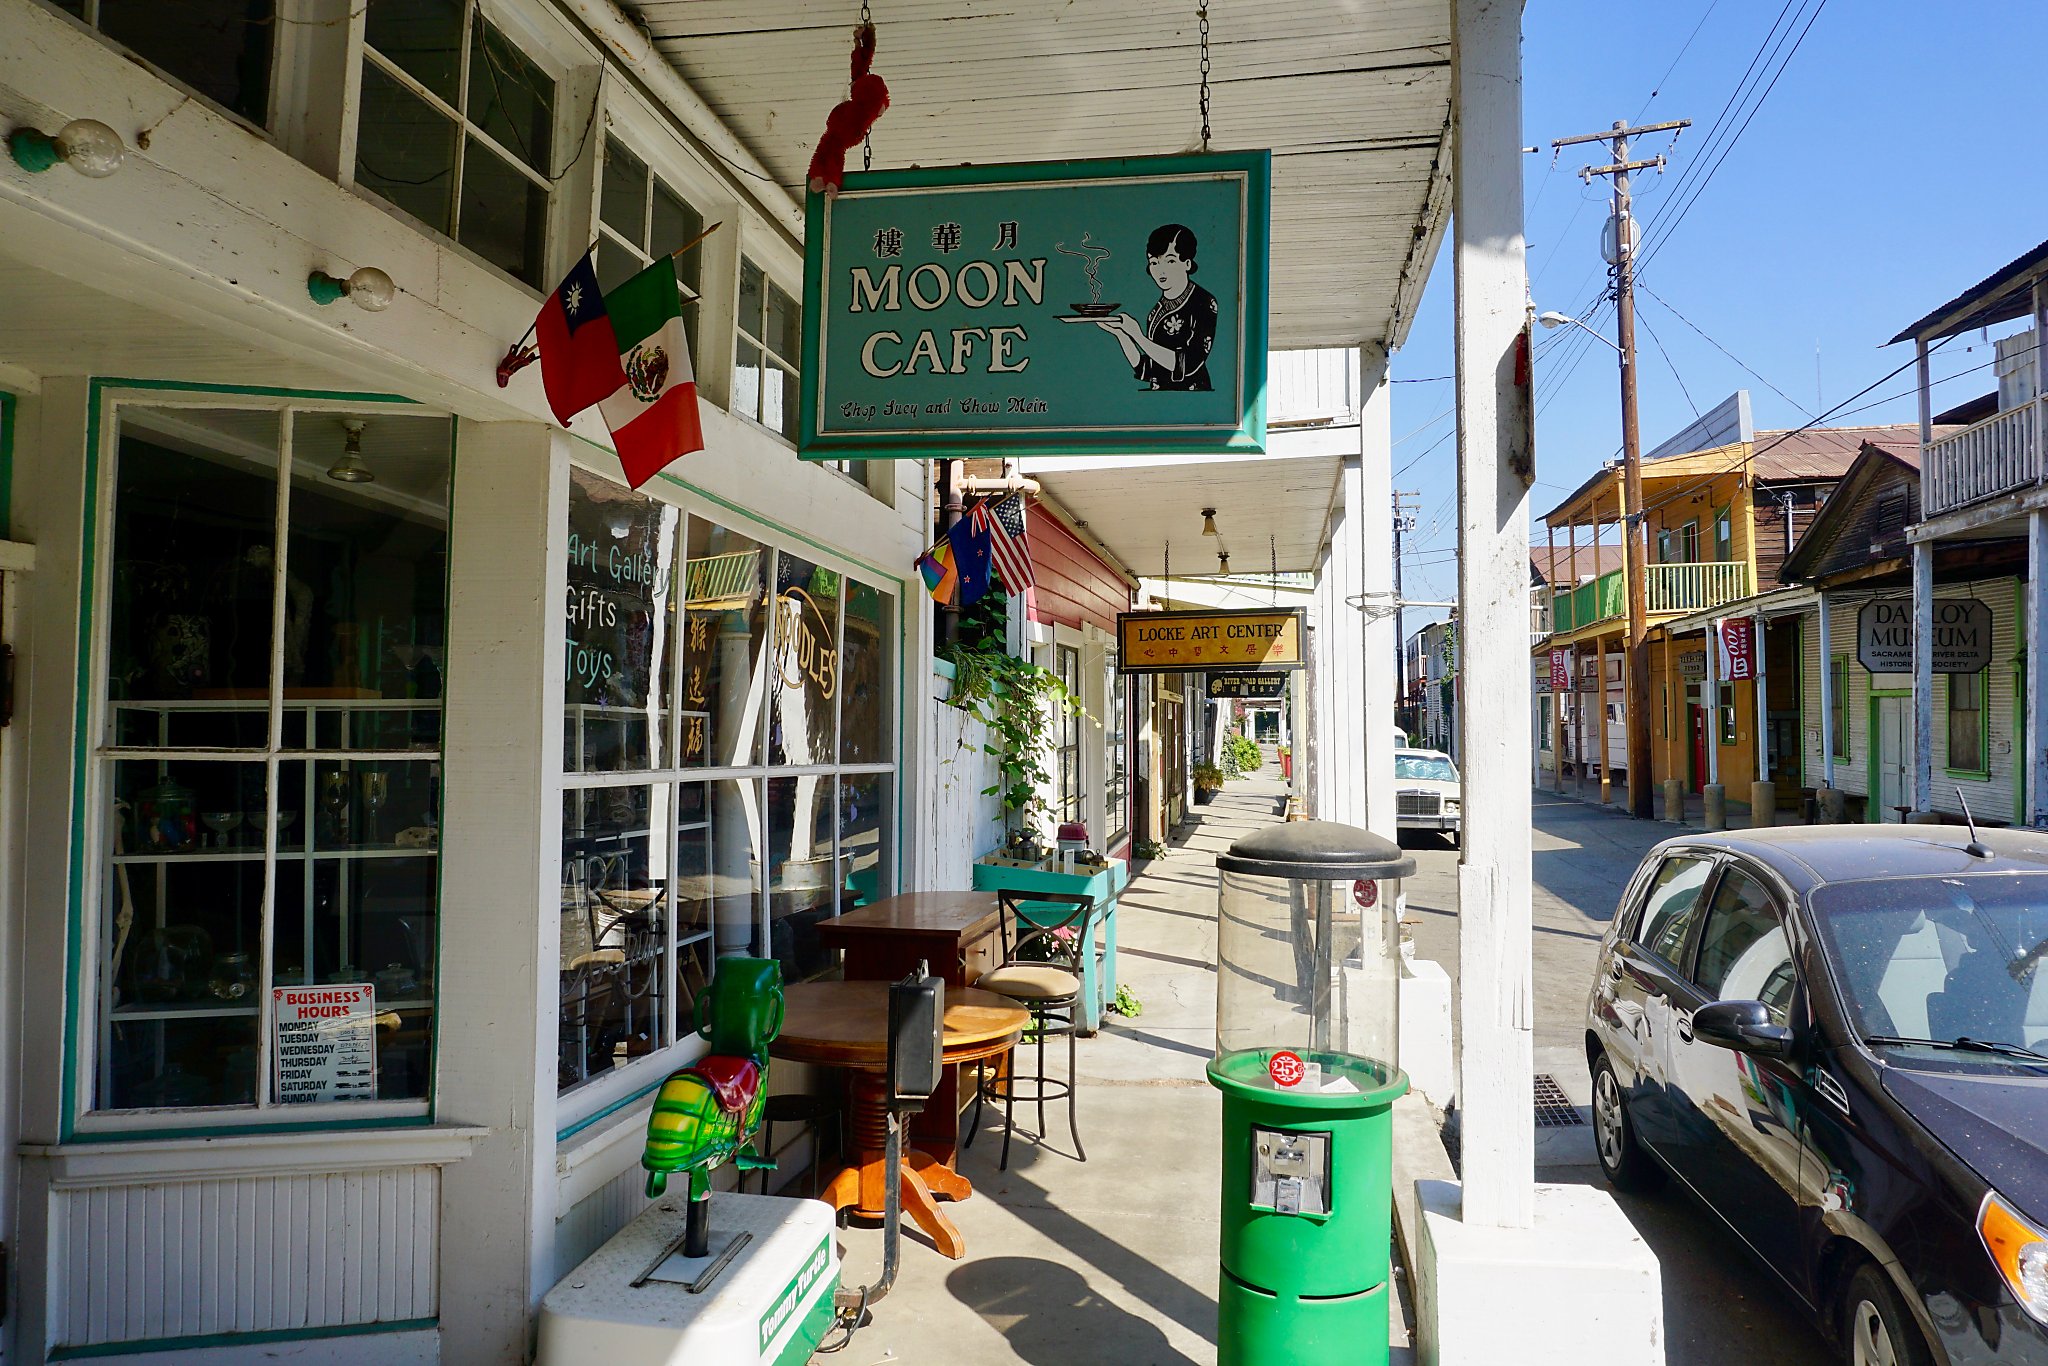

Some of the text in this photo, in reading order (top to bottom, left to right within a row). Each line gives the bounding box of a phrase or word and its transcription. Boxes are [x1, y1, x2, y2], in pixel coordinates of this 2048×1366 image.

[849, 257, 1048, 313] MOON
[860, 324, 1030, 379] CAFE
[840, 396, 1048, 421] Chop Suey and Chow Mein
[567, 533, 671, 598] Art Gallery
[566, 585, 617, 629] Gifts
[1875, 604, 1913, 624] DA
[1138, 624, 1284, 642] LOCKE ART CENTER
[1870, 627, 1978, 647] MUEUM
[774, 599, 838, 700] NOODLES
[565, 638, 612, 688] Toys
[1224, 677, 1240, 685] RIVER
[1257, 677, 1281, 685] GALLERY
[297, 1005, 350, 1020] HOURS
[279, 1021, 319, 1032] MONDAY
[279, 1033, 320, 1044] TUESDAY
[280, 1044, 335, 1056] WEDNESDAY
[280, 1056, 328, 1068] THURSDAY
[1271, 1061, 1304, 1078] 25¢
[280, 1069, 312, 1080] FRIDAY
[281, 1080, 328, 1092] SATURDAY
[281, 1093, 318, 1104] SUNDAY
[761, 1248, 827, 1345] Tommy Turtle
